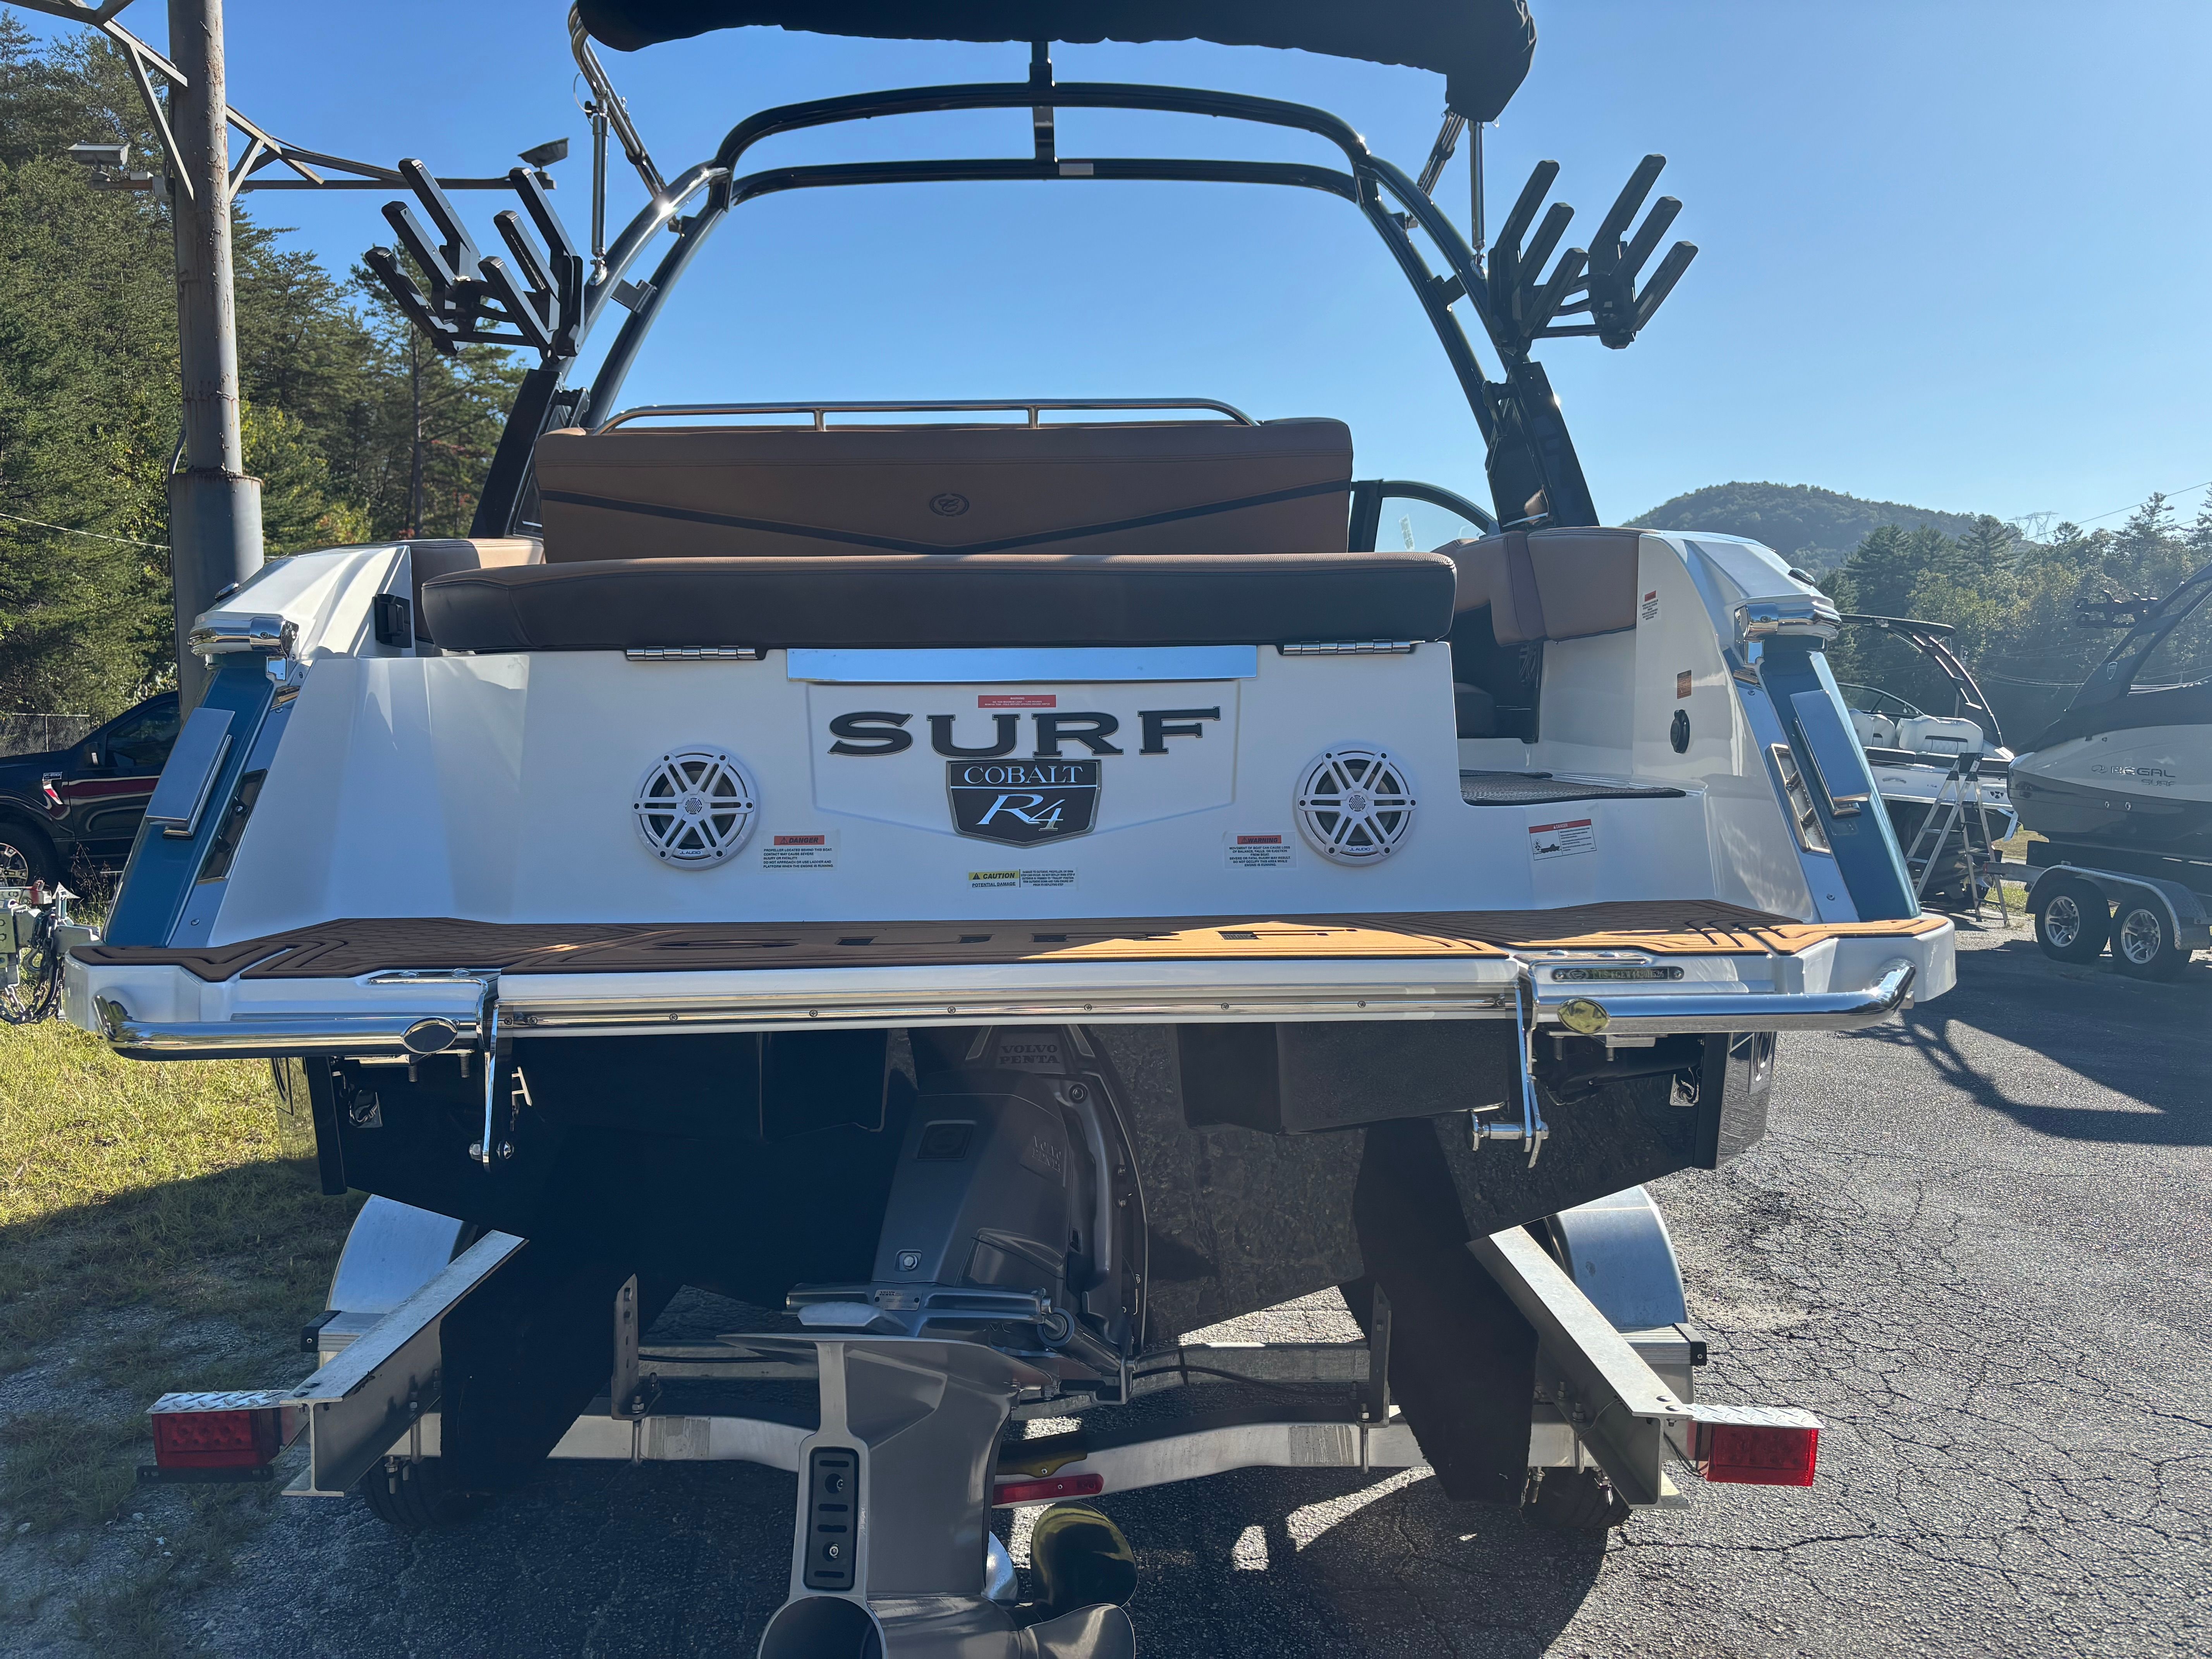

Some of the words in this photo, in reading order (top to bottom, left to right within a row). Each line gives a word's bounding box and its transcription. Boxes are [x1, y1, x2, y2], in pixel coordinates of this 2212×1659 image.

[827, 706, 1221, 758] SURF
[964, 766, 1082, 785] COBALT
[2111, 766, 2175, 777] REGAL
[976, 793, 1066, 831] R4
[1001, 1044, 1058, 1053] VOLVO
[999, 1055, 1060, 1065] PENTA
